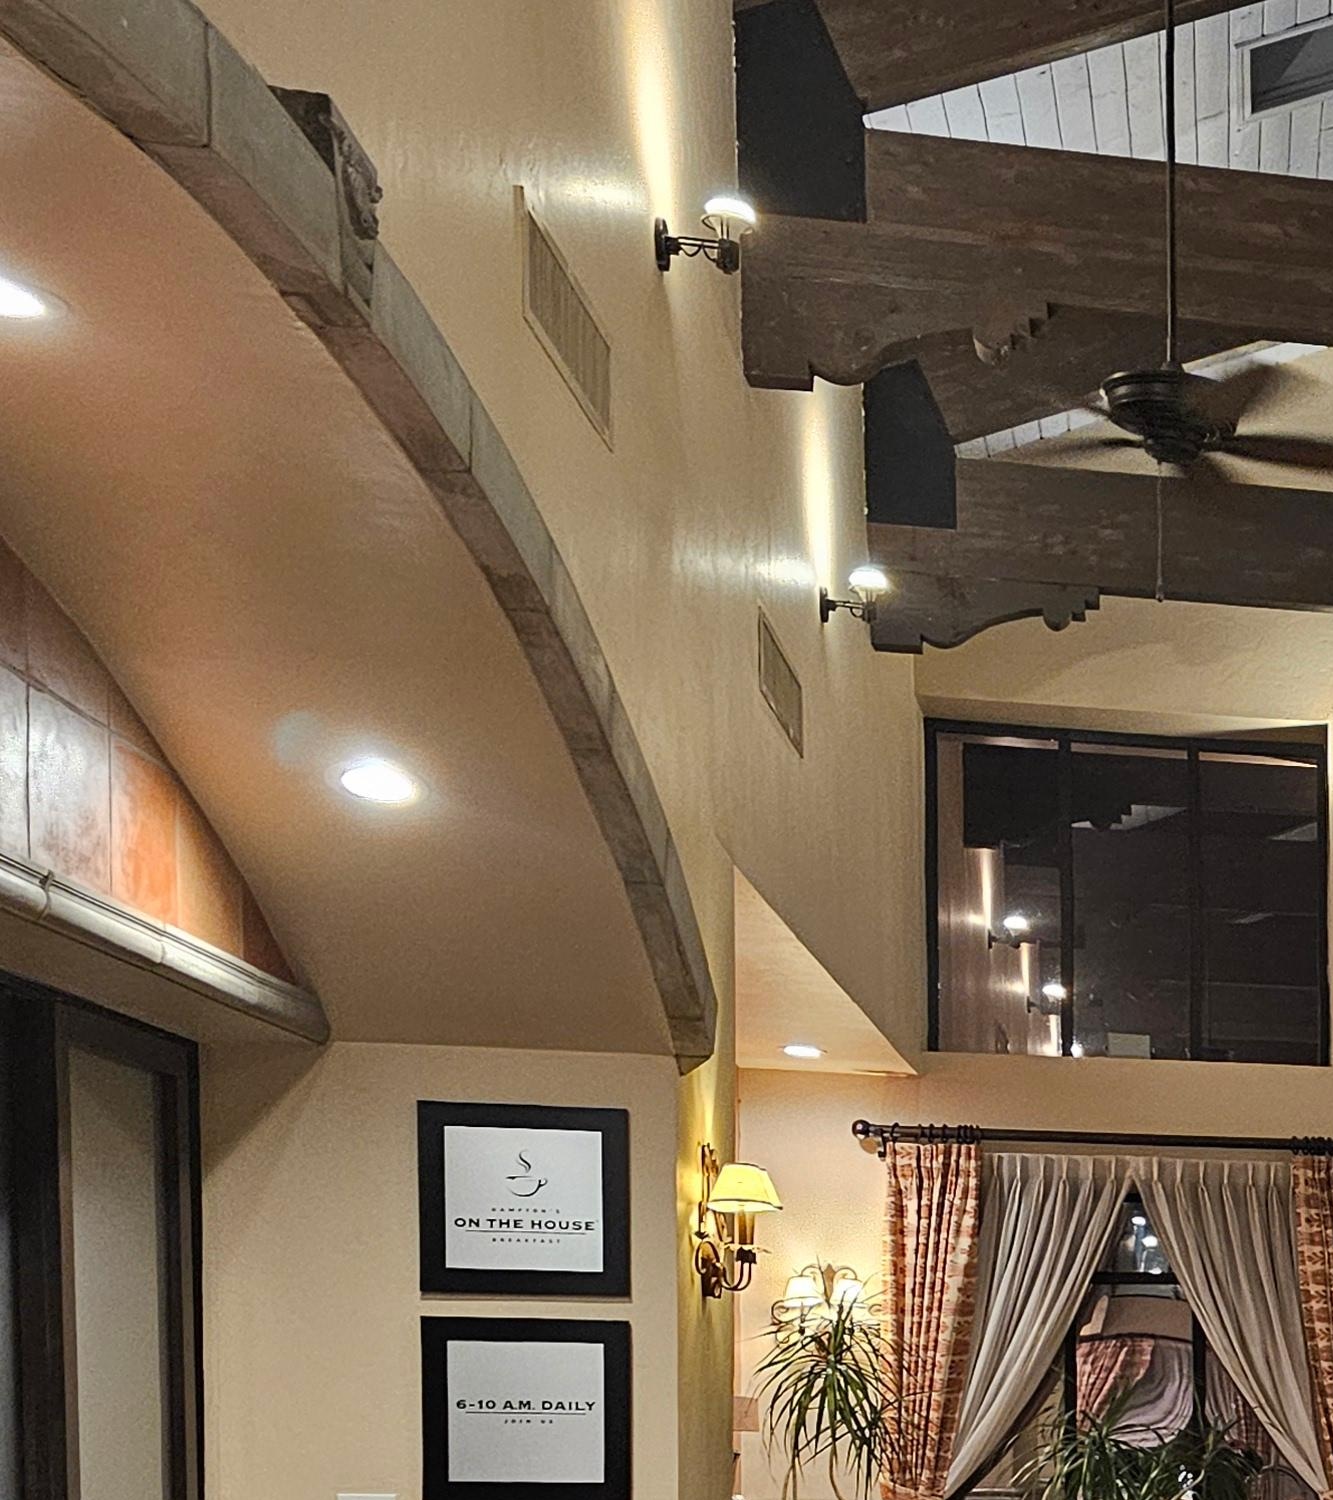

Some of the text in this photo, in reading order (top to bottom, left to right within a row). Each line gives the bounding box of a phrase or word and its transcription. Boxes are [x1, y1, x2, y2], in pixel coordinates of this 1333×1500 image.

[454, 1217, 596, 1231] ON THE HOUSE
[456, 1399, 497, 1410] 6-10
[541, 1401, 596, 1411] DAILY
